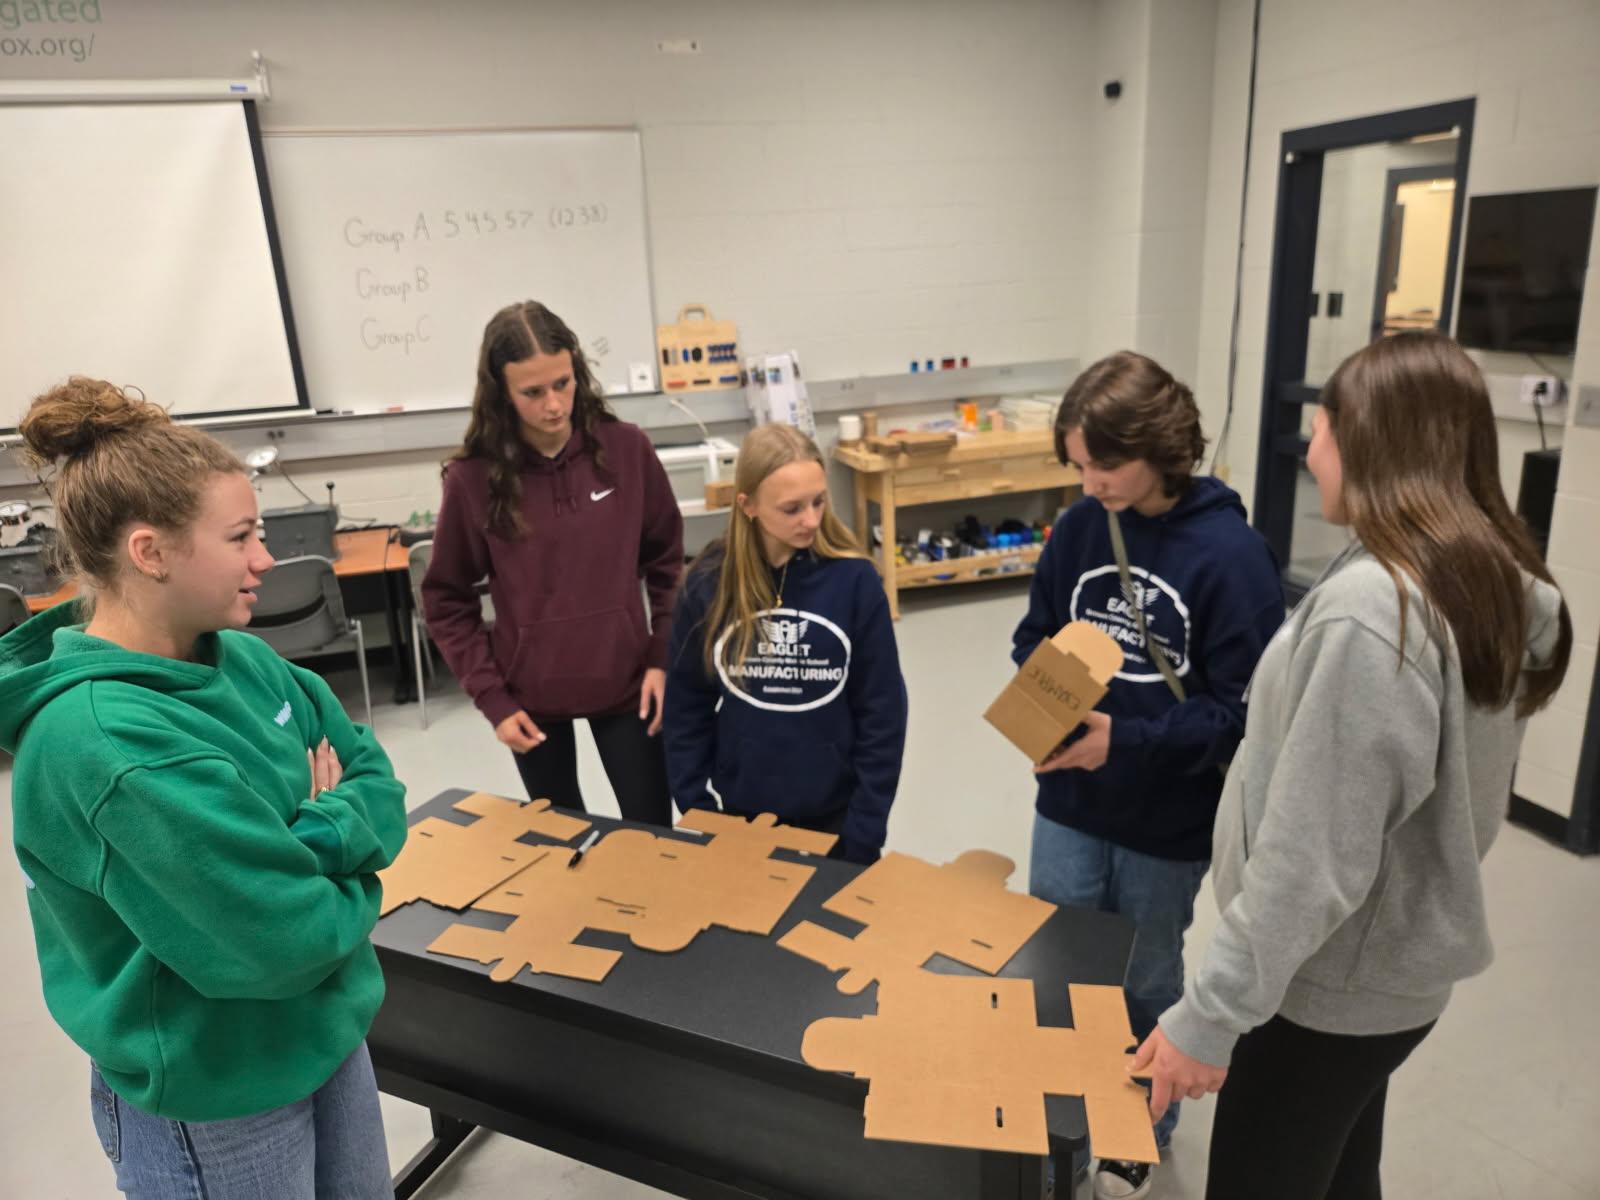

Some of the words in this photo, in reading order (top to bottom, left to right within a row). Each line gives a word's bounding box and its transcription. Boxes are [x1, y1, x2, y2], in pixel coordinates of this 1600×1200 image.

[343, 216, 404, 252] Group
[413, 210, 431, 241] A
[356, 267, 411, 302] Group
[415, 266, 430, 293] B
[360, 316, 416, 354] Group
[1106, 596, 1156, 628] EAGT
[728, 664, 842, 681] MANUFACTURING
